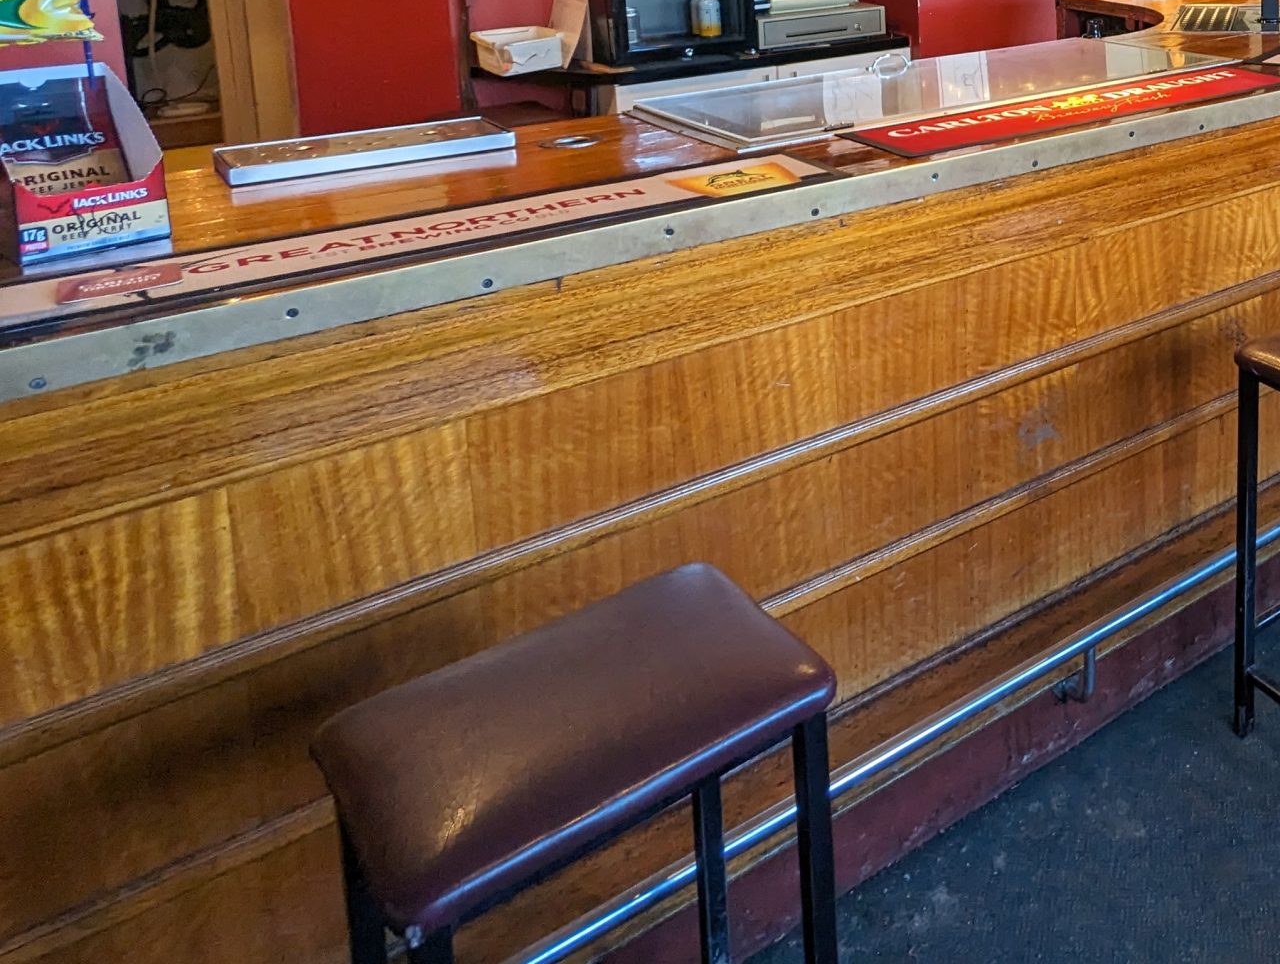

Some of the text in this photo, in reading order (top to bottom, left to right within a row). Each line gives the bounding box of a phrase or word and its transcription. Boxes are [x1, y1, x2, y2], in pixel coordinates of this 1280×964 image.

[886, 69, 1237, 139] CARLTON DRAUGHT
[0, 138, 42, 156] ACK
[22, 228, 47, 243] 17g
[51, 210, 142, 235] ORIGINAL
[187, 188, 646, 275] GREAT NORTHERN
[358, 223, 490, 252] BREWING
